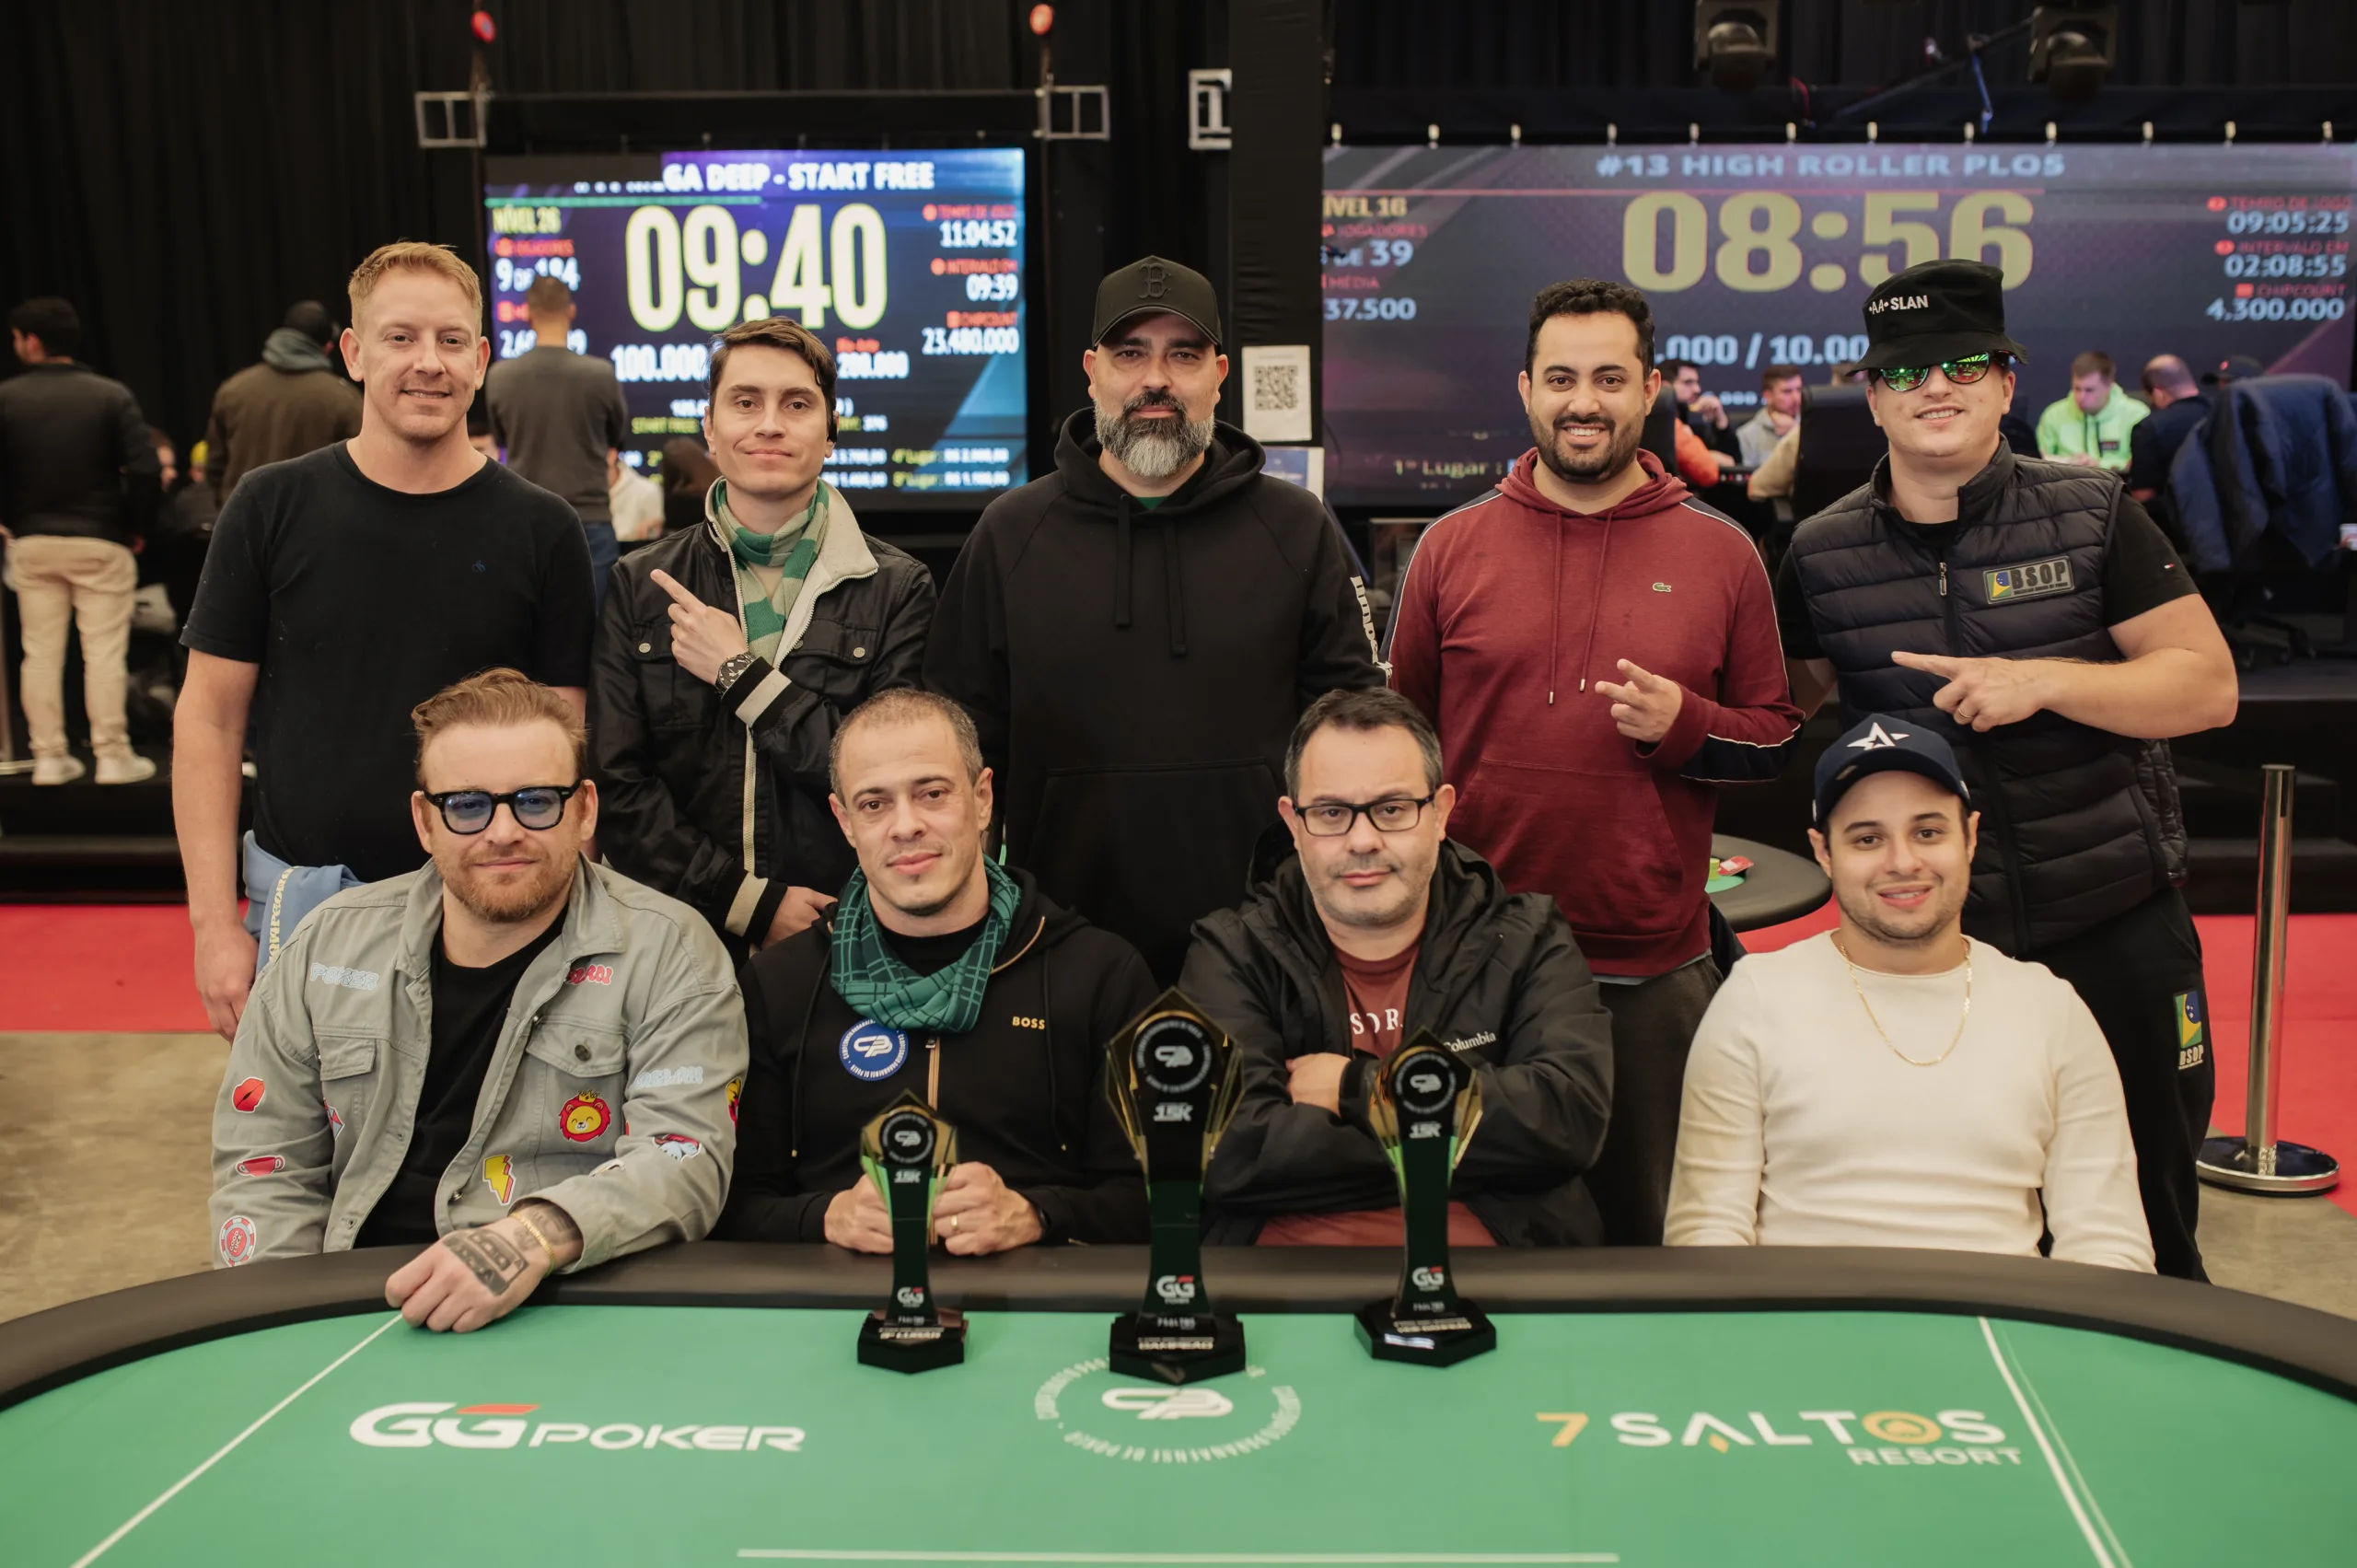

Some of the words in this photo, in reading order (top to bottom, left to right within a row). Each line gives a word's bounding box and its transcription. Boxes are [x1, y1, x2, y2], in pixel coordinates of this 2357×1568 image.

[706, 162, 771, 192] DEEP
[788, 162, 871, 191] START
[874, 161, 935, 190] FREE
[1596, 154, 1669, 177] #13
[1681, 154, 1784, 177] HIGH
[1797, 154, 1950, 177] ROLLER
[2227, 211, 2350, 234] 09:05:25
[1368, 239, 1414, 267] 39
[1622, 191, 2034, 293] 08:56
[625, 203, 888, 332] 09:40
[2224, 254, 2347, 277] 02:08:55
[2206, 297, 2345, 320] 4.300.000
[1422, 459, 1490, 479] Lugar
[2010, 561, 2066, 589] BSOP
[1012, 1016, 1046, 1030] BOSS
[2178, 1044, 2204, 1066] BSOP
[1156, 1275, 1195, 1299] GG
[1535, 1412, 1589, 1446] 7
[1609, 1410, 2006, 1454] SALTOS
[1846, 1446, 2022, 1466] RESORT
